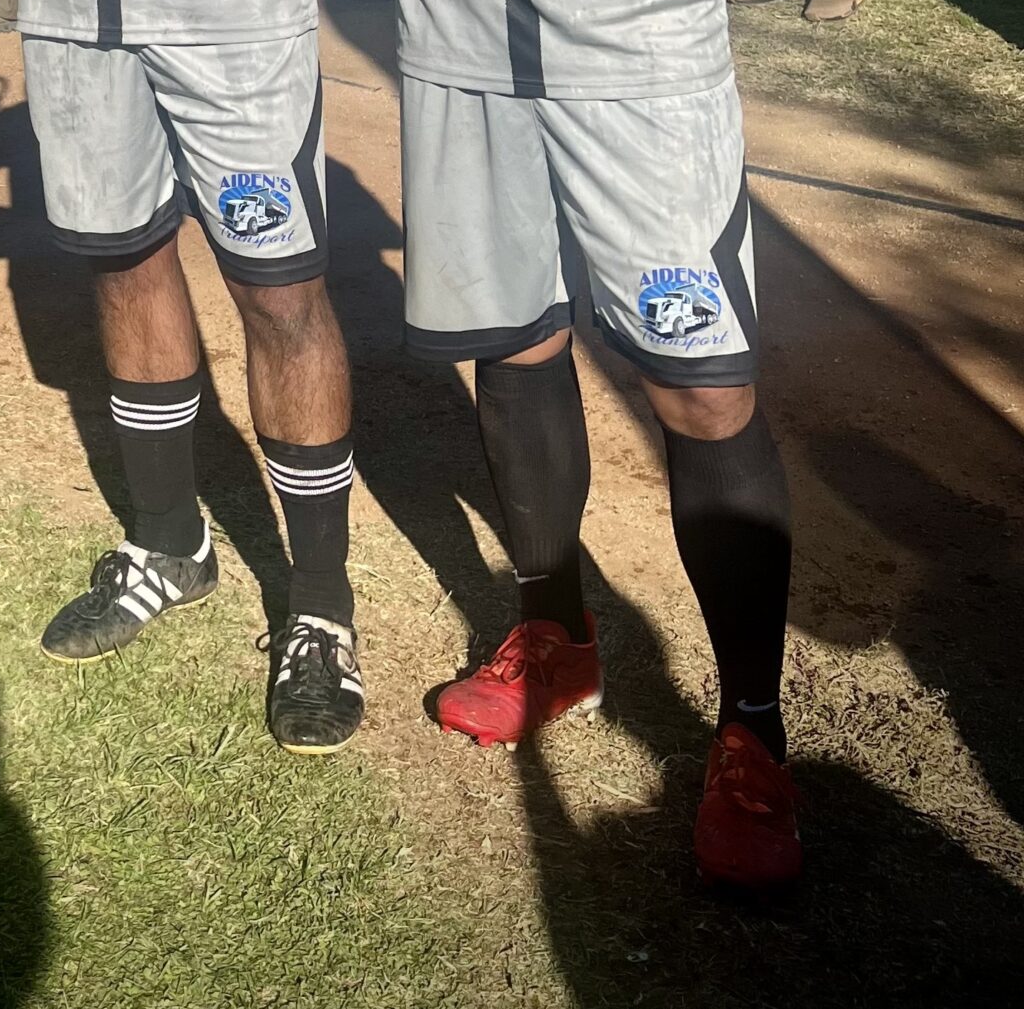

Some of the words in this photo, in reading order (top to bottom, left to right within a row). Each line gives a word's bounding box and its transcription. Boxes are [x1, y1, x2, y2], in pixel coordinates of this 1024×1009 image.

[220, 173, 292, 193] AIDEN'S
[218, 221, 296, 248] Transport
[639, 267, 720, 288] AIDEN'S
[637, 324, 728, 352] Transport
